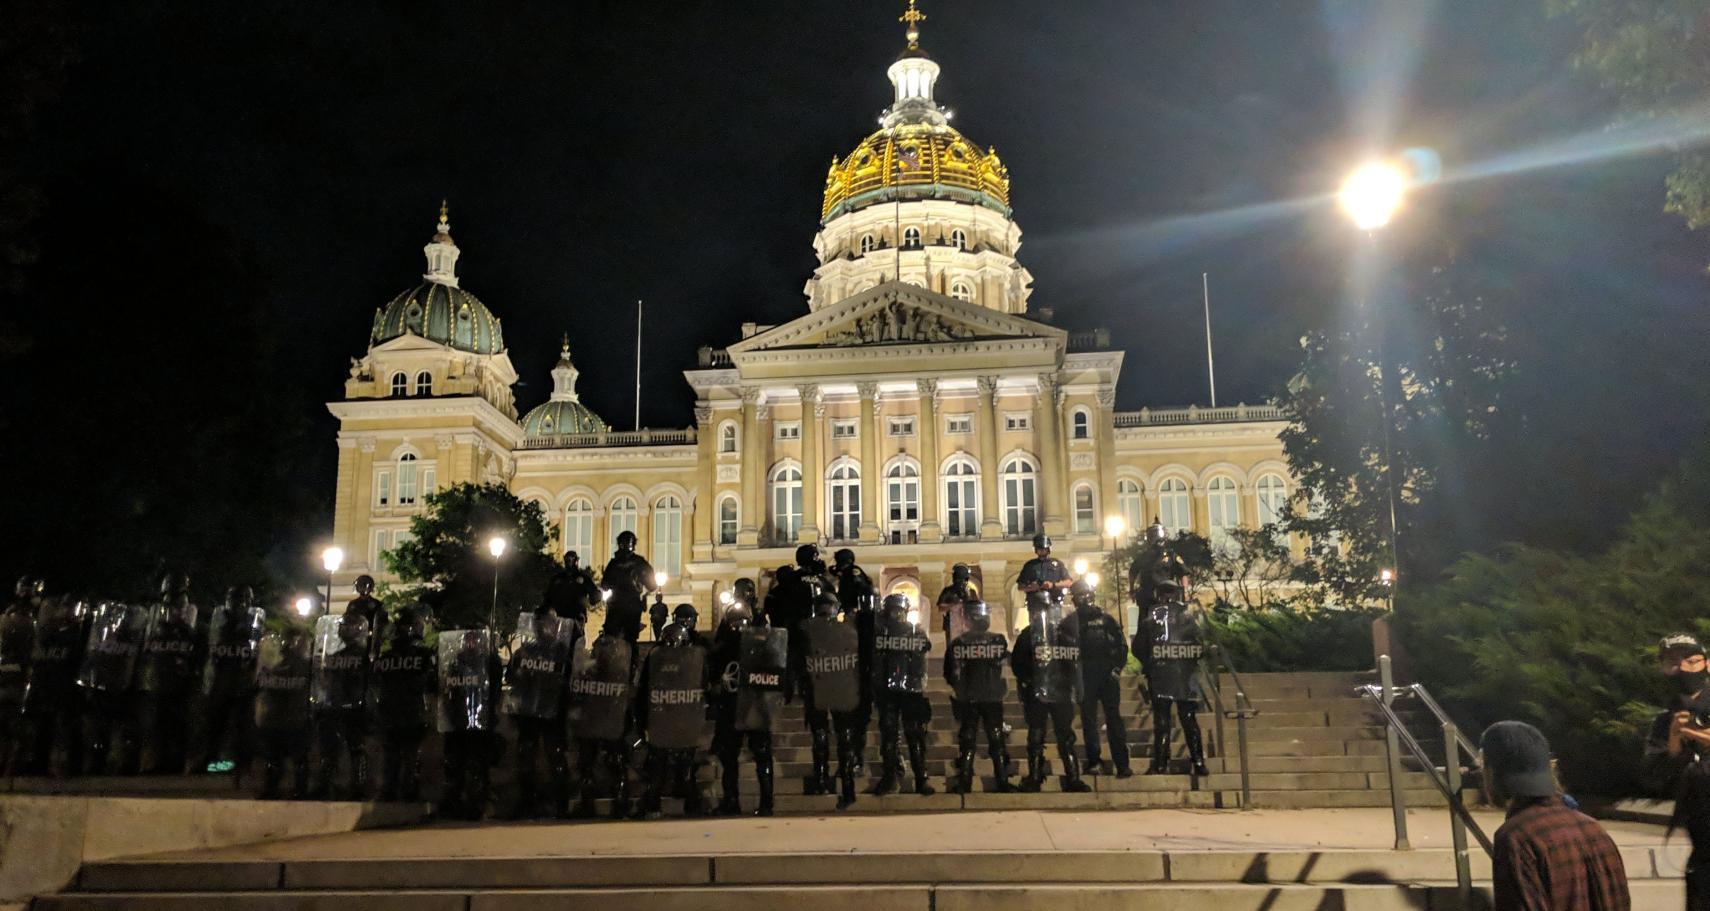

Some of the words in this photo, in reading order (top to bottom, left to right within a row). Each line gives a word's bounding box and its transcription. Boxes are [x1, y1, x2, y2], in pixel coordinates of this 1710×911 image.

[875, 636, 926, 650] SHERIFF
[953, 645, 1004, 659] SHERIFF
[1153, 645, 1202, 659] SHERIFF
[374, 656, 423, 671] POLICE
[521, 658, 556, 672] POLICE
[806, 654, 859, 672] SHERIFF
[446, 675, 479, 687] POLICE
[749, 673, 780, 685] POLICE
[572, 679, 625, 697] SHERIFF
[650, 689, 704, 704] SHERIFF
